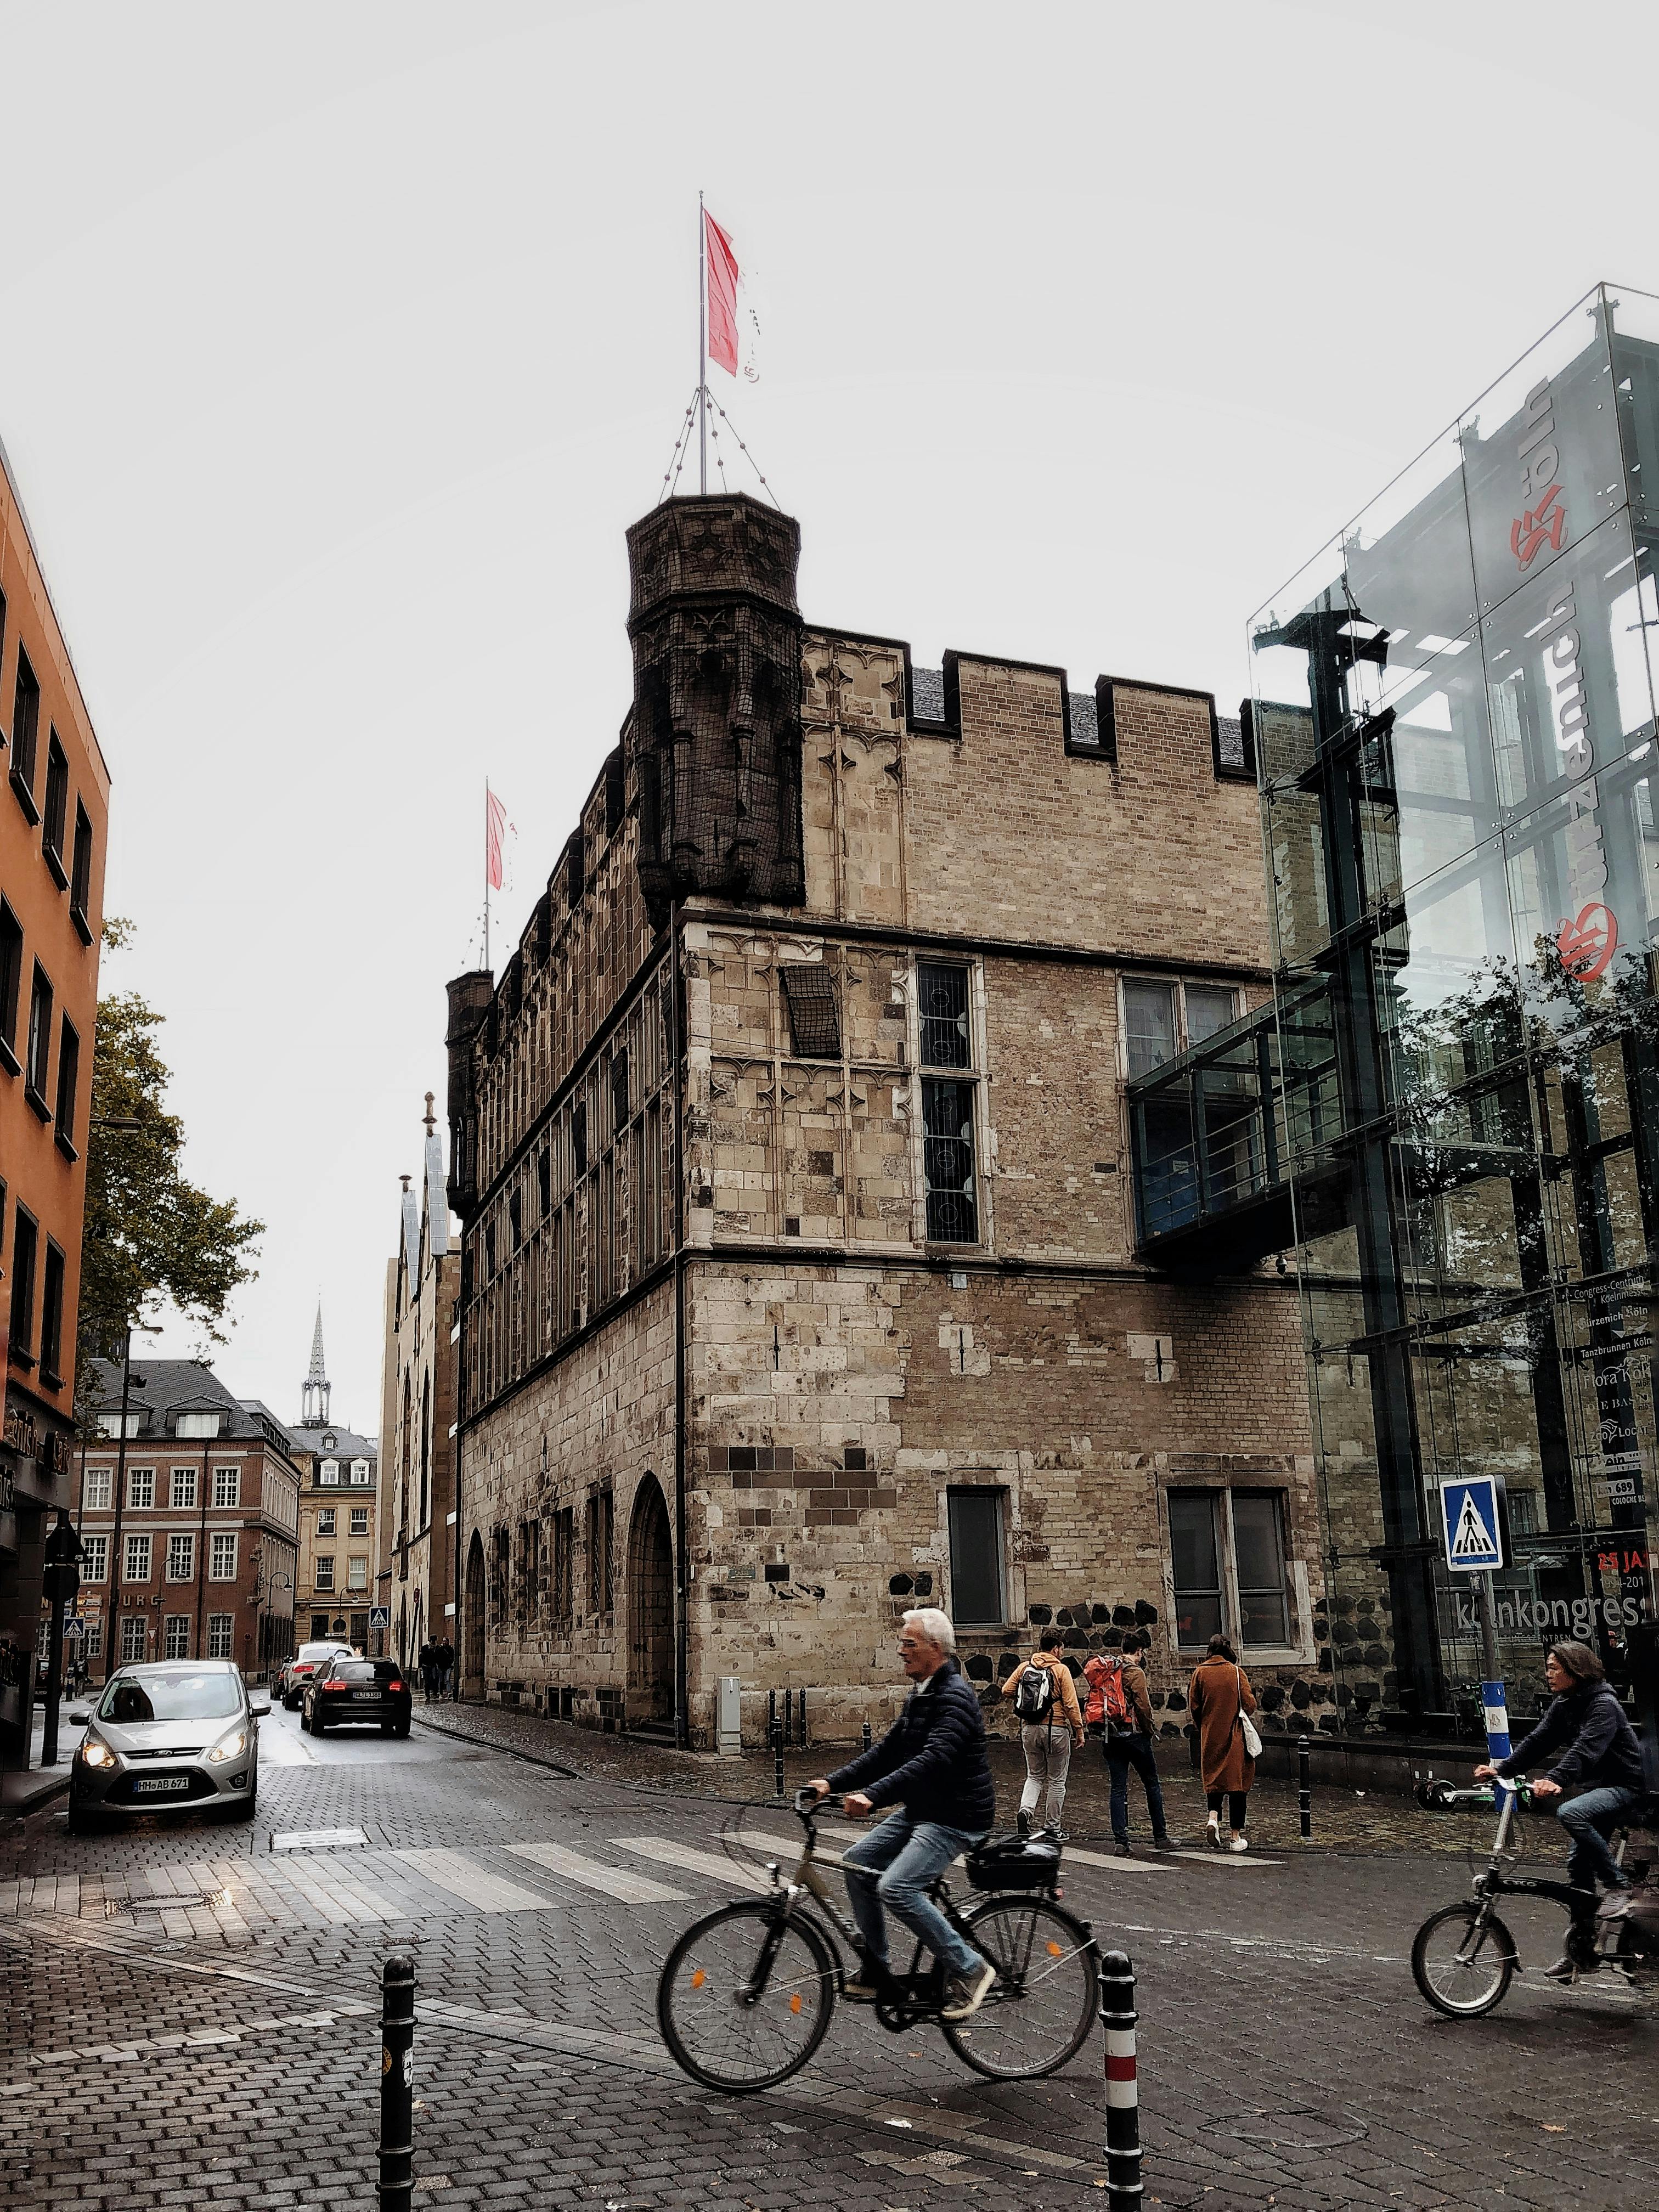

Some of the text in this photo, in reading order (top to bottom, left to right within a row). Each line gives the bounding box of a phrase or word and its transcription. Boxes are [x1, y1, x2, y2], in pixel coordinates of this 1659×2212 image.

[1574, 1274, 1644, 1299] Congress-Centrum
[1580, 1336, 1652, 1358] Tanzbrunnen Köln
[1615, 1481, 1633, 1493] 689
[1598, 1552, 1619, 1571] 25
[1455, 1590, 1646, 1639] klnkongres
[171, 1779, 188, 1788] 671
